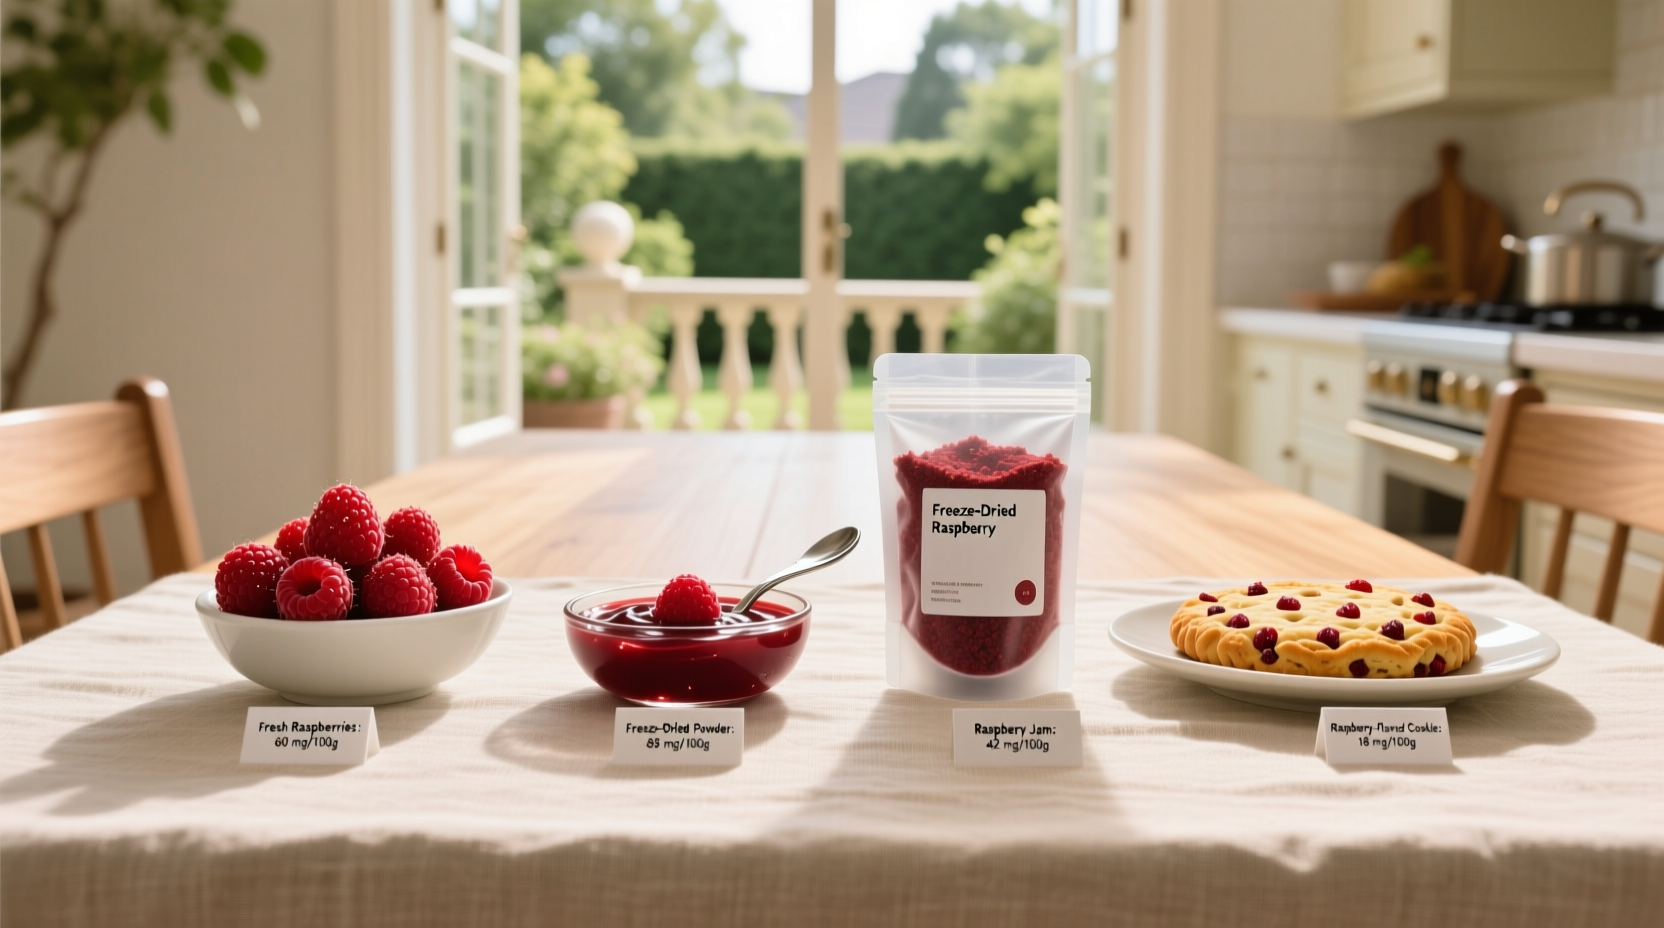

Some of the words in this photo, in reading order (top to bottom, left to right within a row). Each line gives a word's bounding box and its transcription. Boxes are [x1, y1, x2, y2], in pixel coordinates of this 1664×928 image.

[932, 503, 1016, 517] Freeze-Dried
[931, 520, 996, 538] Raspberry
[258, 720, 288, 732] Fresh
[291, 720, 361, 737] Raspberries:
[693, 722, 734, 734] Powder:
[1029, 723, 1056, 735] Jam:
[274, 736, 289, 747] 60
[291, 736, 338, 751] mg/100g
[664, 737, 710, 752] mg/100g
[986, 739, 1000, 749] 42
[1003, 739, 1049, 753] mg/100g
[1372, 736, 1416, 750] mg/100g
